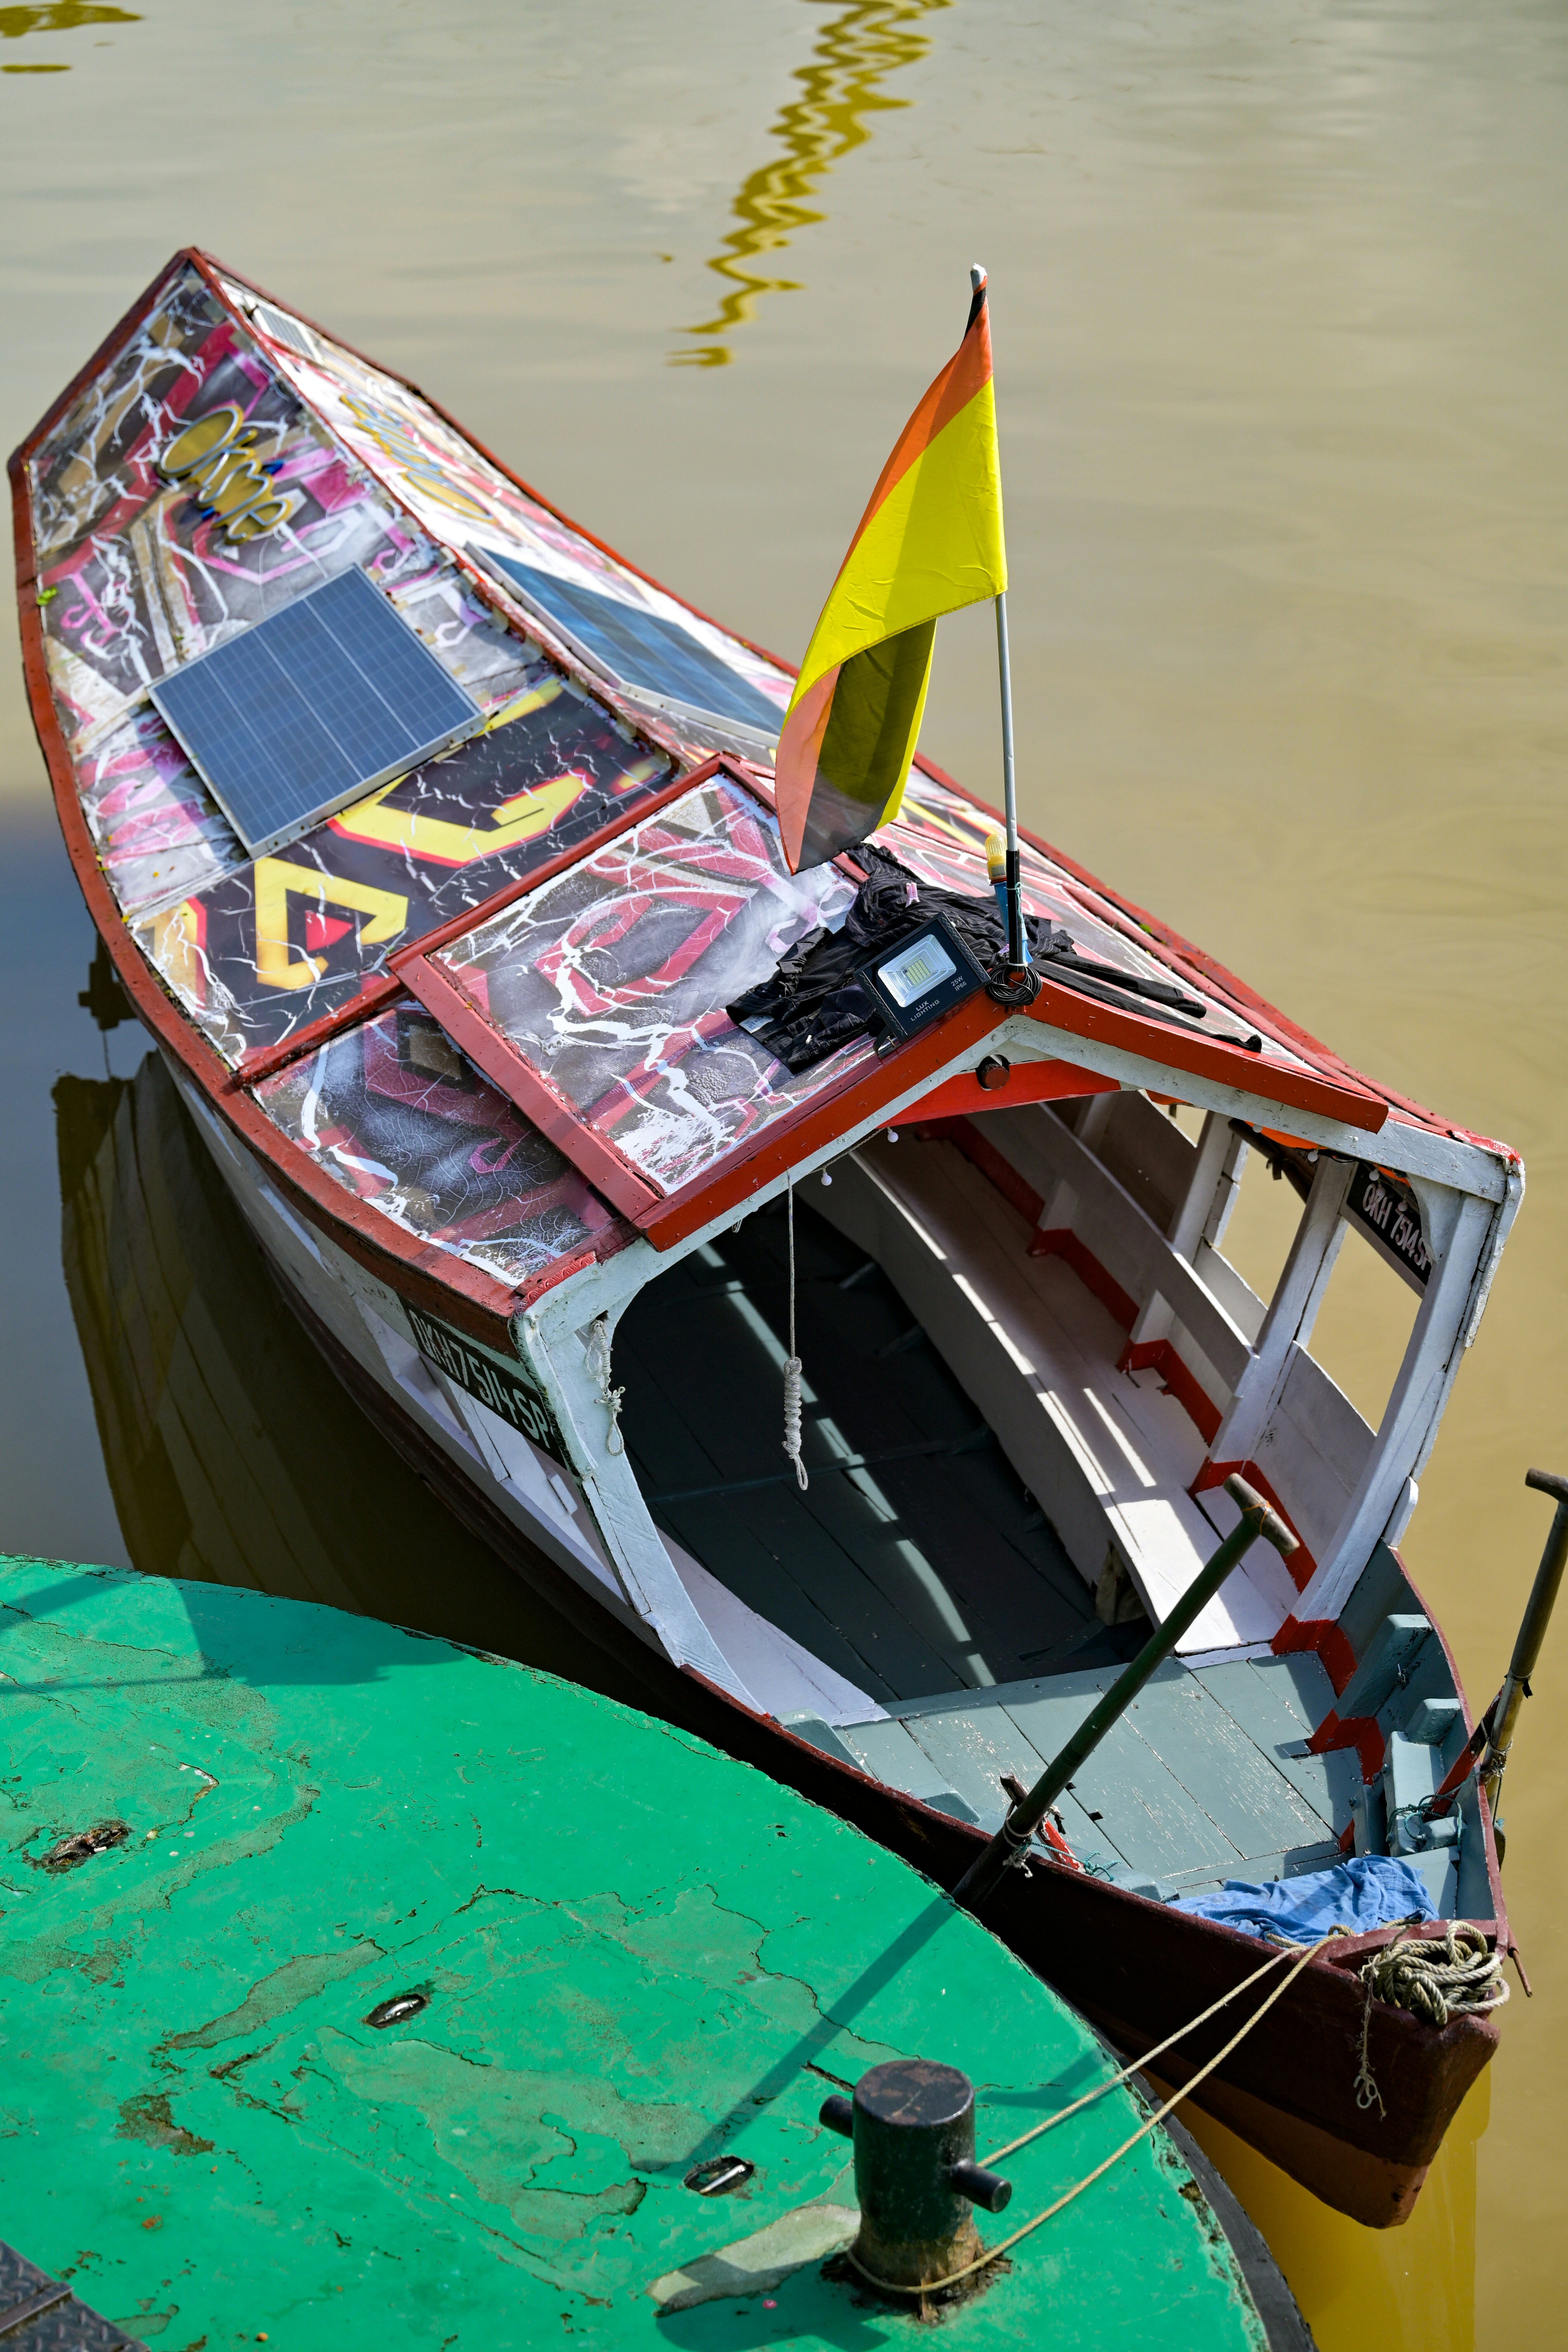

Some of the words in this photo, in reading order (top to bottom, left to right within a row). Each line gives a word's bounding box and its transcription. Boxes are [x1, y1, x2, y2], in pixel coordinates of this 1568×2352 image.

[951, 975, 963, 987] 25W
[954, 981, 967, 991] IP66
[910, 999, 940, 1021] LIGHTING
[915, 1000, 929, 1011] LUX
